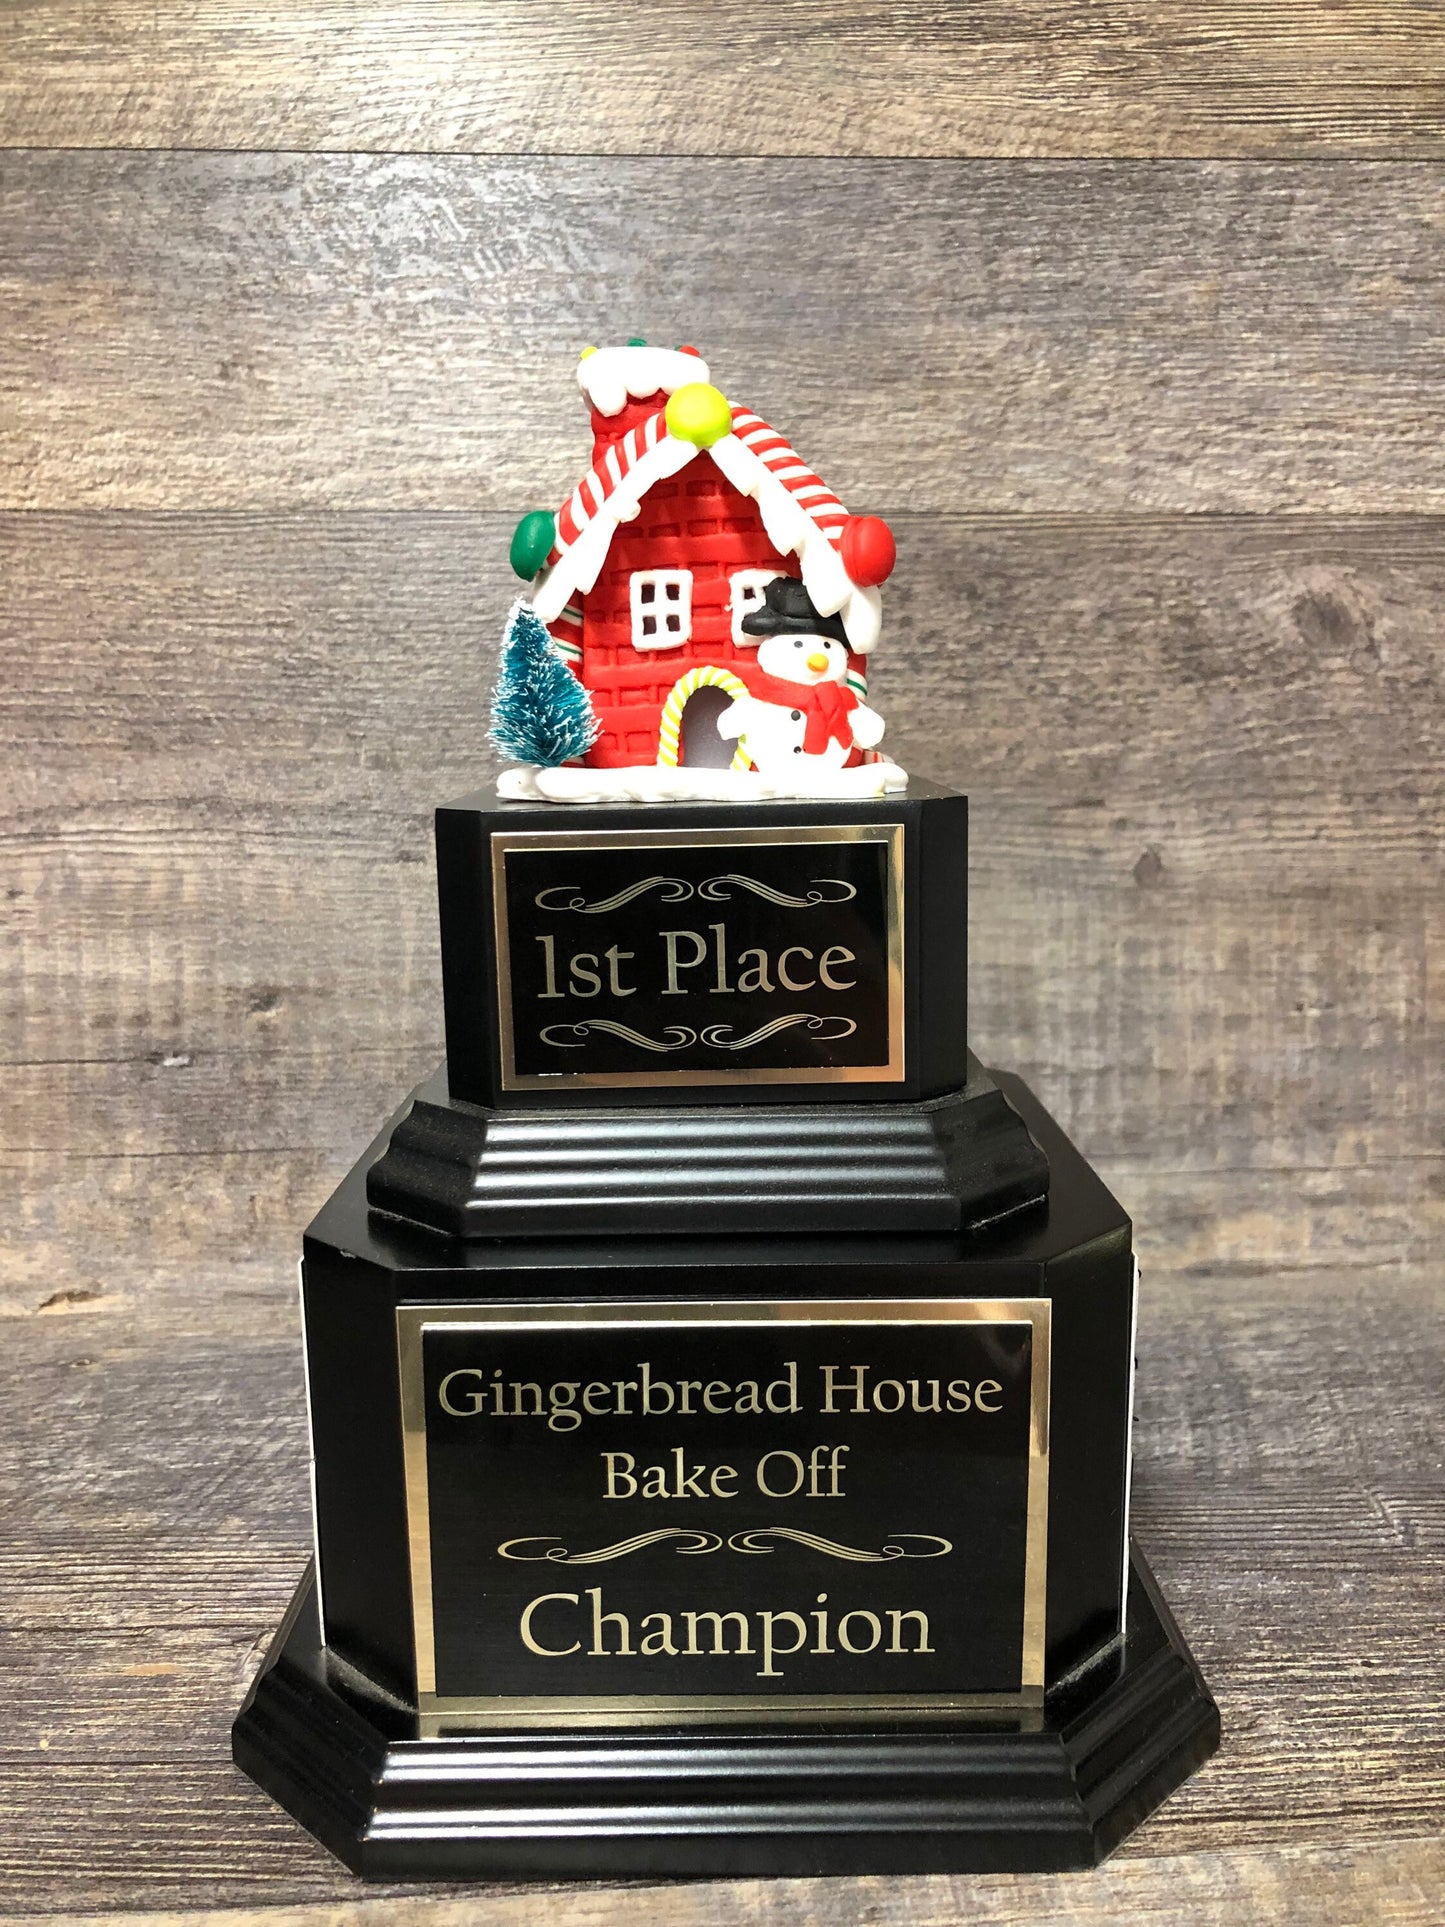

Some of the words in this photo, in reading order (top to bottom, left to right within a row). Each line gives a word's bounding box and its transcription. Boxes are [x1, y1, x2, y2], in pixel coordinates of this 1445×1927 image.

[535, 934, 637, 998] 1st
[658, 922, 857, 995] Place
[438, 1362, 803, 1432] Gingerbread
[819, 1365, 1003, 1414] House
[600, 1446, 738, 1499] Bake
[756, 1445, 849, 1498] Off
[519, 1586, 936, 1678] Champion
